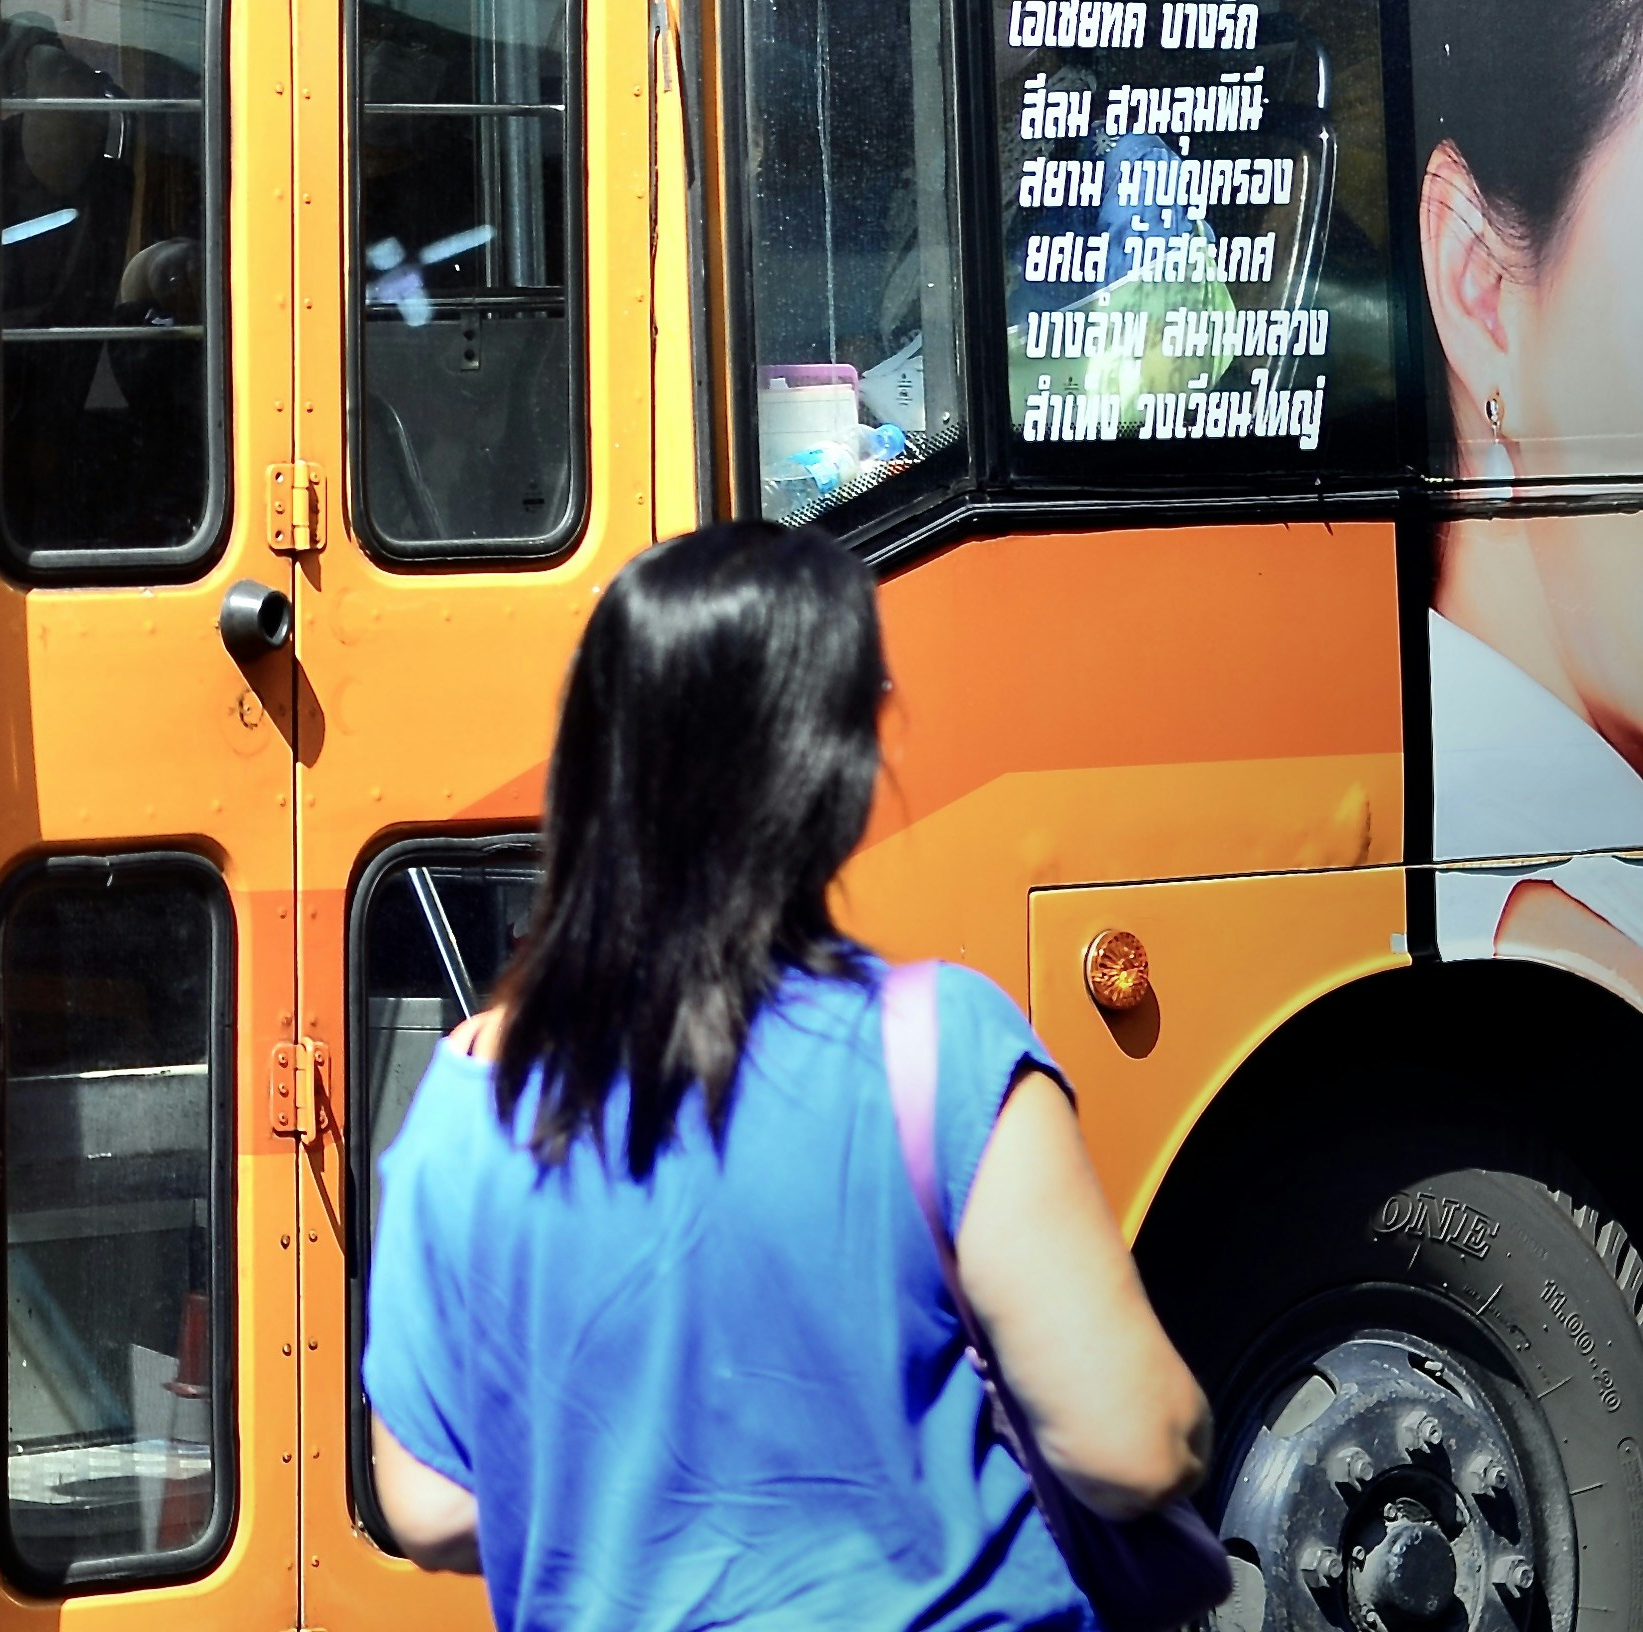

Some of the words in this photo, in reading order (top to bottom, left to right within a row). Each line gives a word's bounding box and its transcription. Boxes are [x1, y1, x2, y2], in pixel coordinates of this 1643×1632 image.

[1020, 73, 1092, 139] สีลม
[1105, 66, 1264, 155] สวนลุมพินี
[1019, 157, 1105, 207] สยาม
[1118, 158, 1294, 229] มาบุญครอง
[1025, 232, 1109, 283] ยศเส
[1123, 217, 1276, 284] วัดสระเกศ
[1163, 306, 1330, 357] สนามหลวง
[1138, 368, 1326, 451] วงเวียนใหญ่
